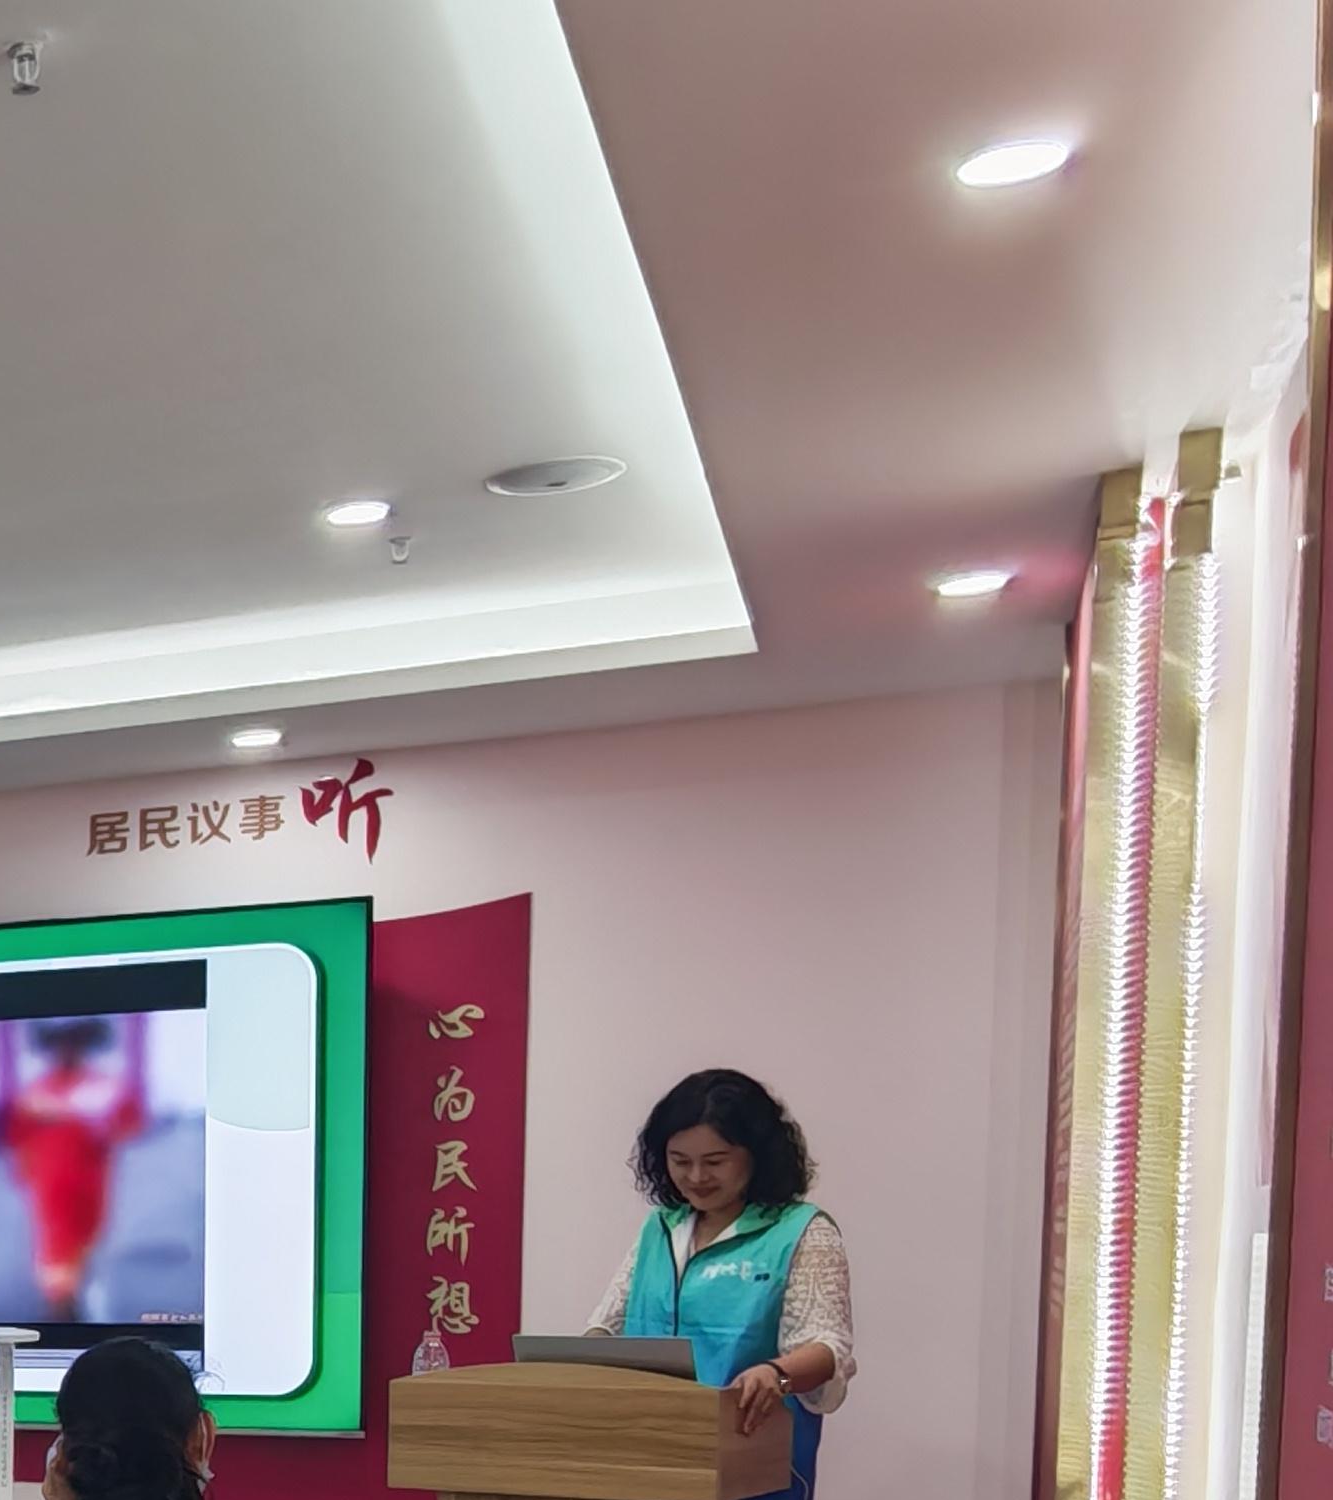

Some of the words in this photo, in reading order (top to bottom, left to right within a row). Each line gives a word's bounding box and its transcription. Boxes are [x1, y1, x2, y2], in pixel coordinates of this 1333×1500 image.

[427, 1003, 485, 1335] 心为民所想
